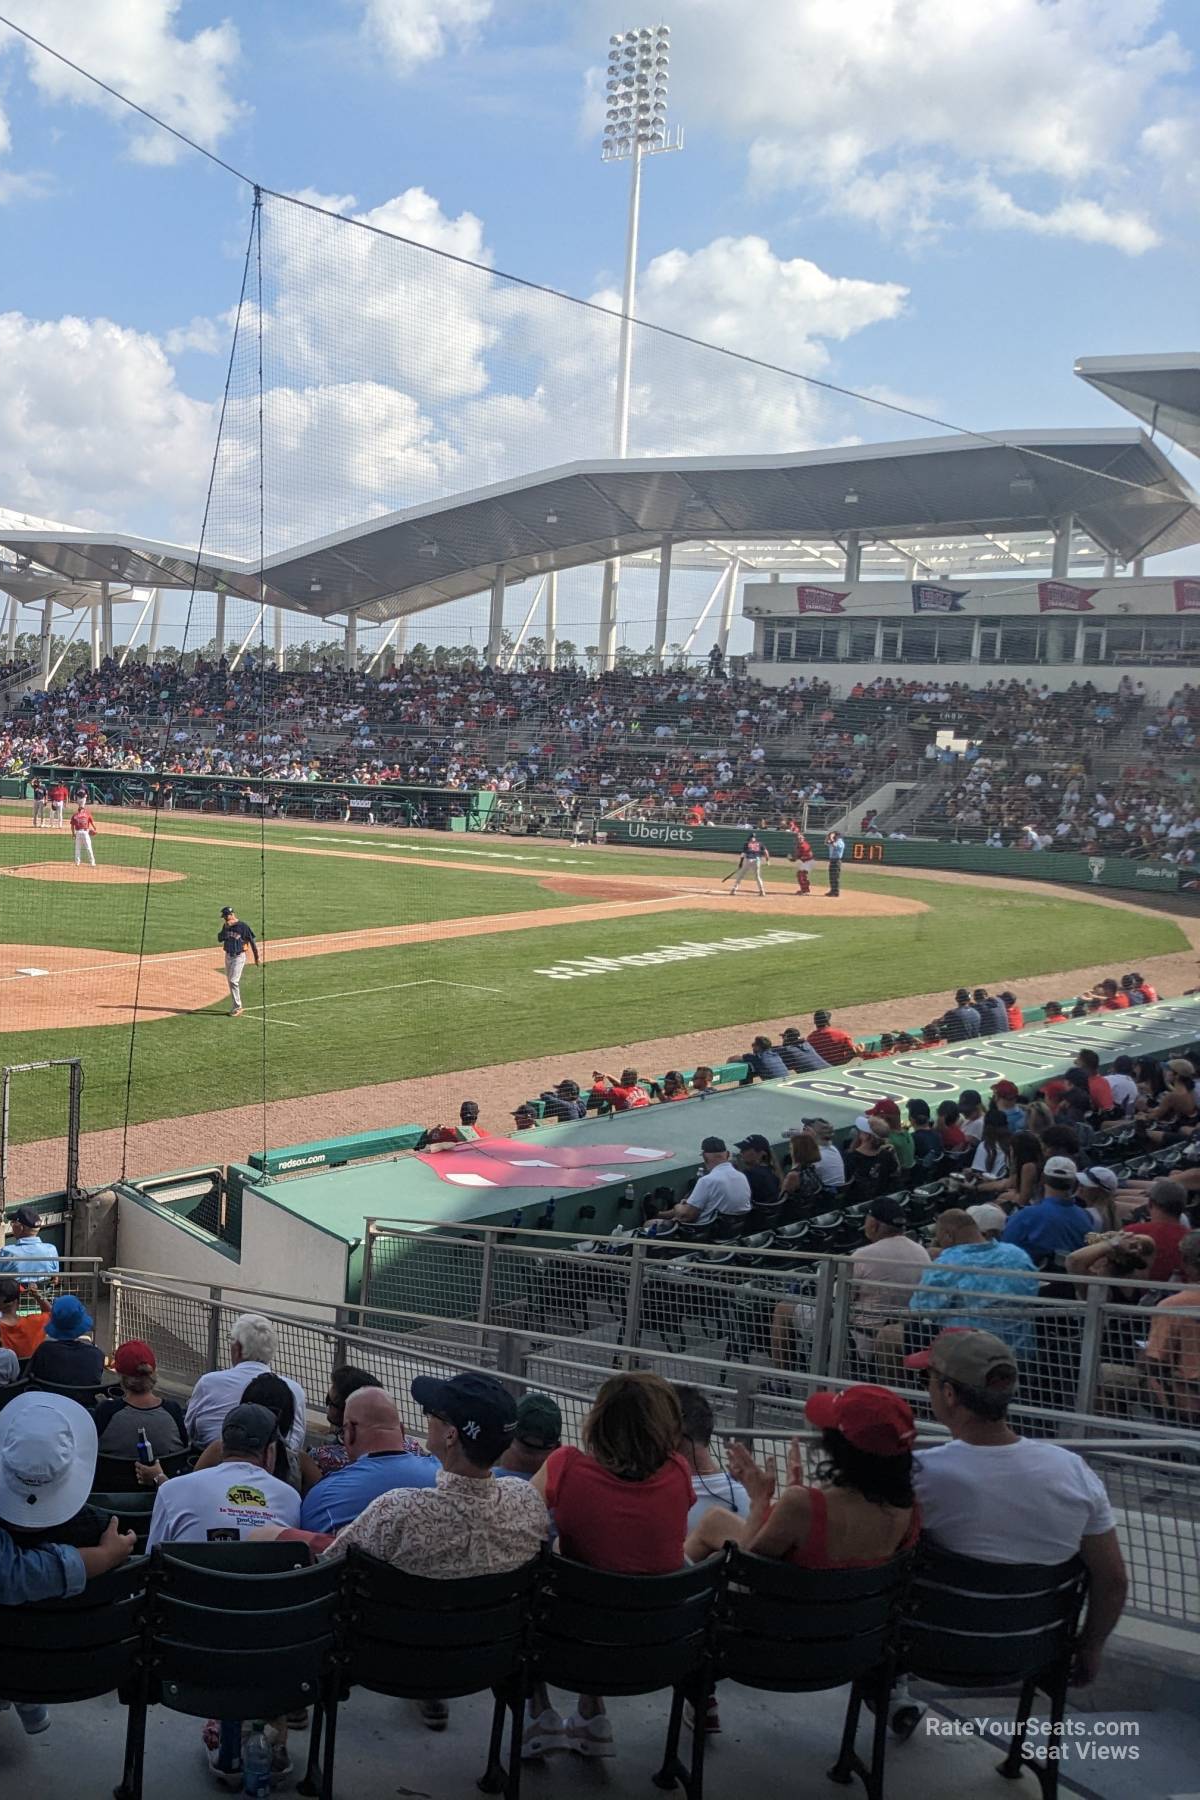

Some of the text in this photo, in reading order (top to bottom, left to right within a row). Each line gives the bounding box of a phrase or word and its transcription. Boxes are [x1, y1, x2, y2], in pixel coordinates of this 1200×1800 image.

[628, 823, 694, 842] UberJets
[555, 929, 824, 971] MassMutual
[778, 1030, 1143, 1105] BOSTON
[278, 1153, 325, 1170] redsox.com
